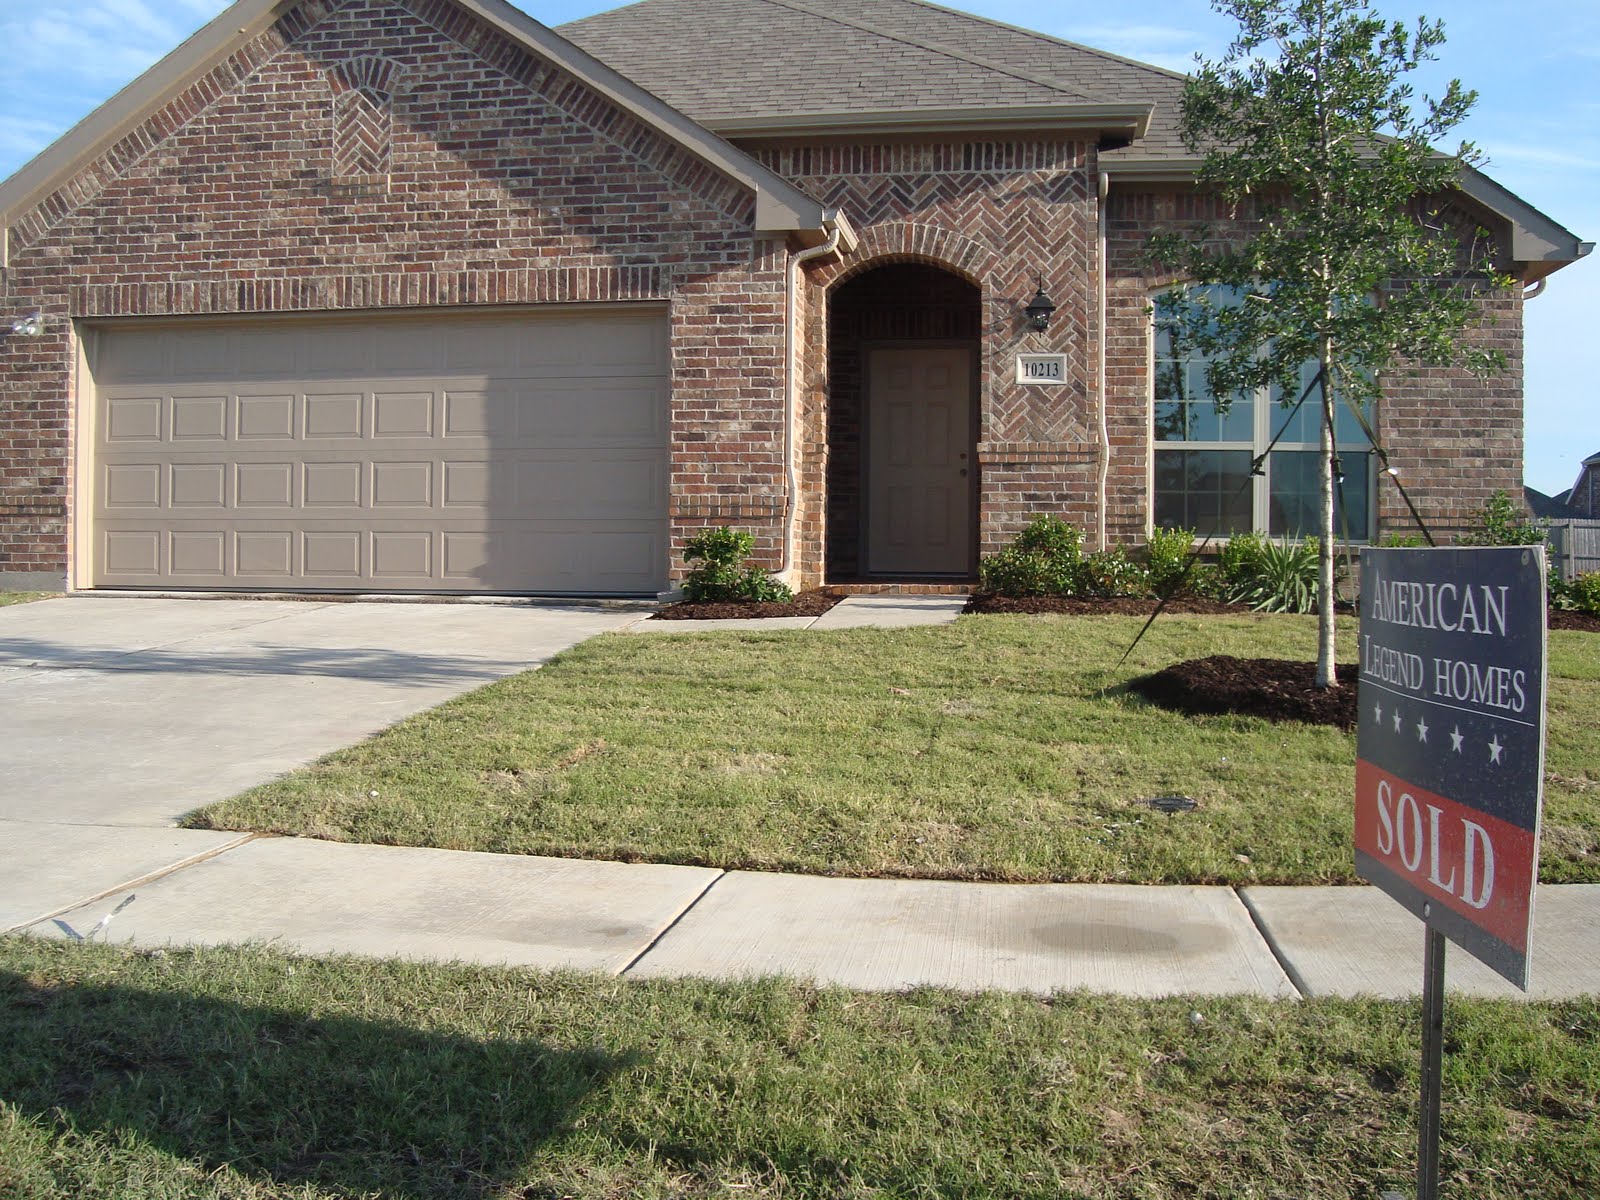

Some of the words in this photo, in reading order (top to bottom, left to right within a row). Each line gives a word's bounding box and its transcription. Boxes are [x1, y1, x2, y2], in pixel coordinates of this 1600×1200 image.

[1024, 362, 1059, 377] 10213
[1371, 568, 1509, 637] AMERICAN
[1363, 634, 1424, 690] LEGEND
[1433, 657, 1525, 713] HOMES
[1377, 780, 1495, 909] SOLD
